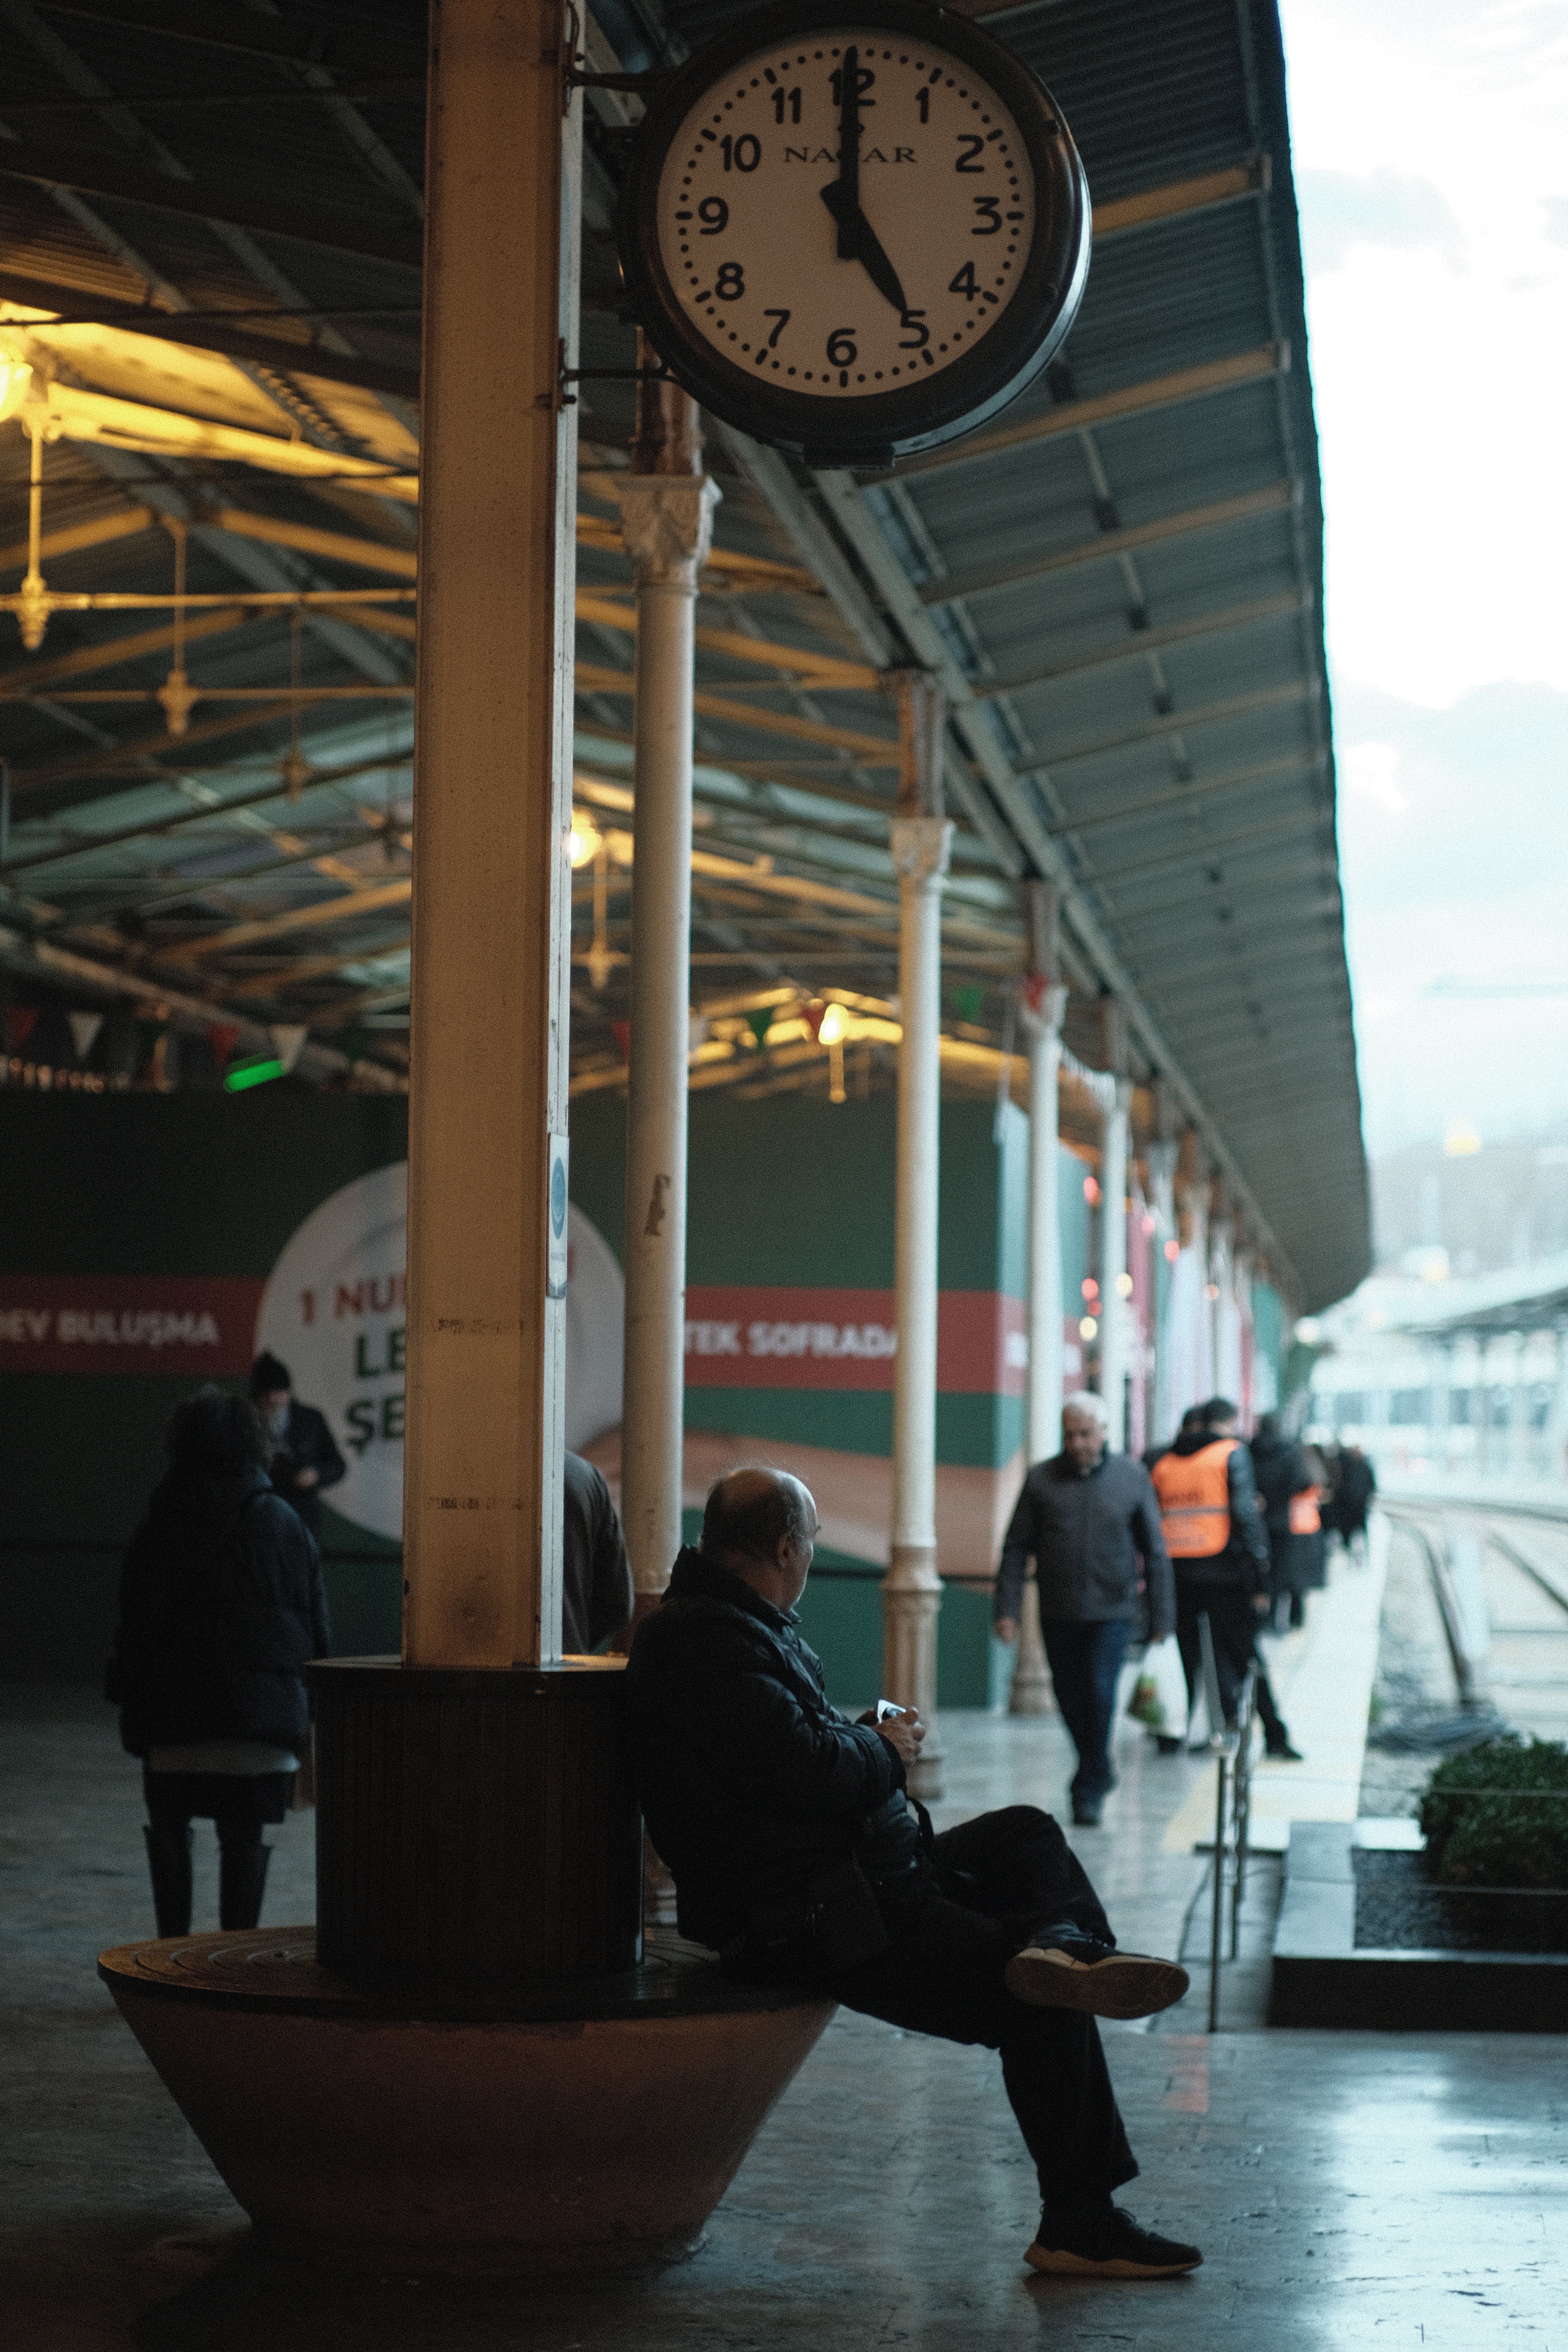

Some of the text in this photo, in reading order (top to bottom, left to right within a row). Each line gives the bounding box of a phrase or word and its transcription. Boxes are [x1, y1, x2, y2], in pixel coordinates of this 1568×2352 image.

[771, 87, 801, 124] 11
[828, 68, 876, 106] 12
[915, 87, 929, 124] 1
[720, 134, 761, 173] 10
[783, 147, 917, 163] NAAR
[955, 135, 985, 173] 2
[698, 196, 729, 235] 9
[972, 196, 1002, 235] 3
[715, 262, 745, 301] 8
[948, 261, 981, 302] 4
[764, 309, 791, 348] 7
[826, 328, 858, 368] 6
[899, 309, 930, 349] 5
[334, 1275, 406, 1320] NU
